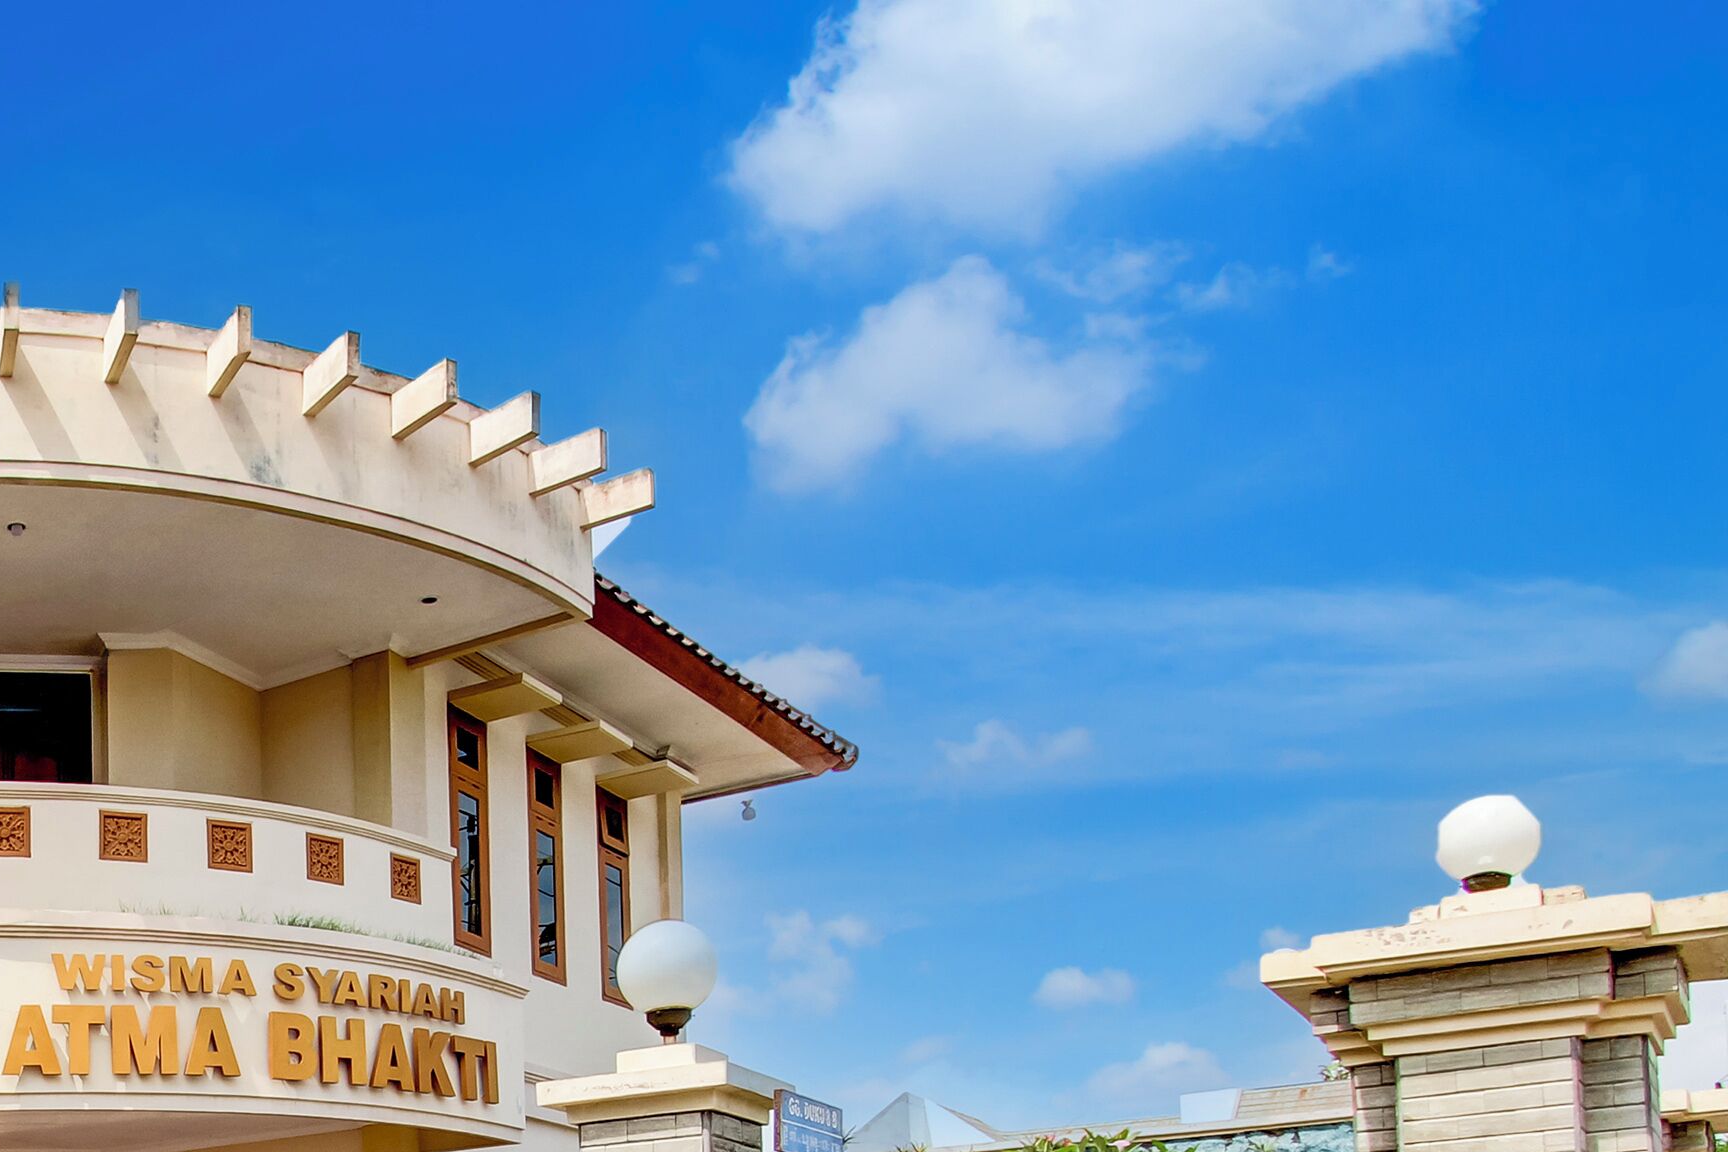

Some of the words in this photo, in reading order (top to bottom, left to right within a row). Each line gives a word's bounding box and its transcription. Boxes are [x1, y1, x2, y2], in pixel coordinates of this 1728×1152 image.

[52, 953, 257, 997] WISMA
[272, 963, 466, 1026] SYARIAH
[2, 1005, 241, 1077] ATMA
[269, 1011, 500, 1105] BHAKTI
